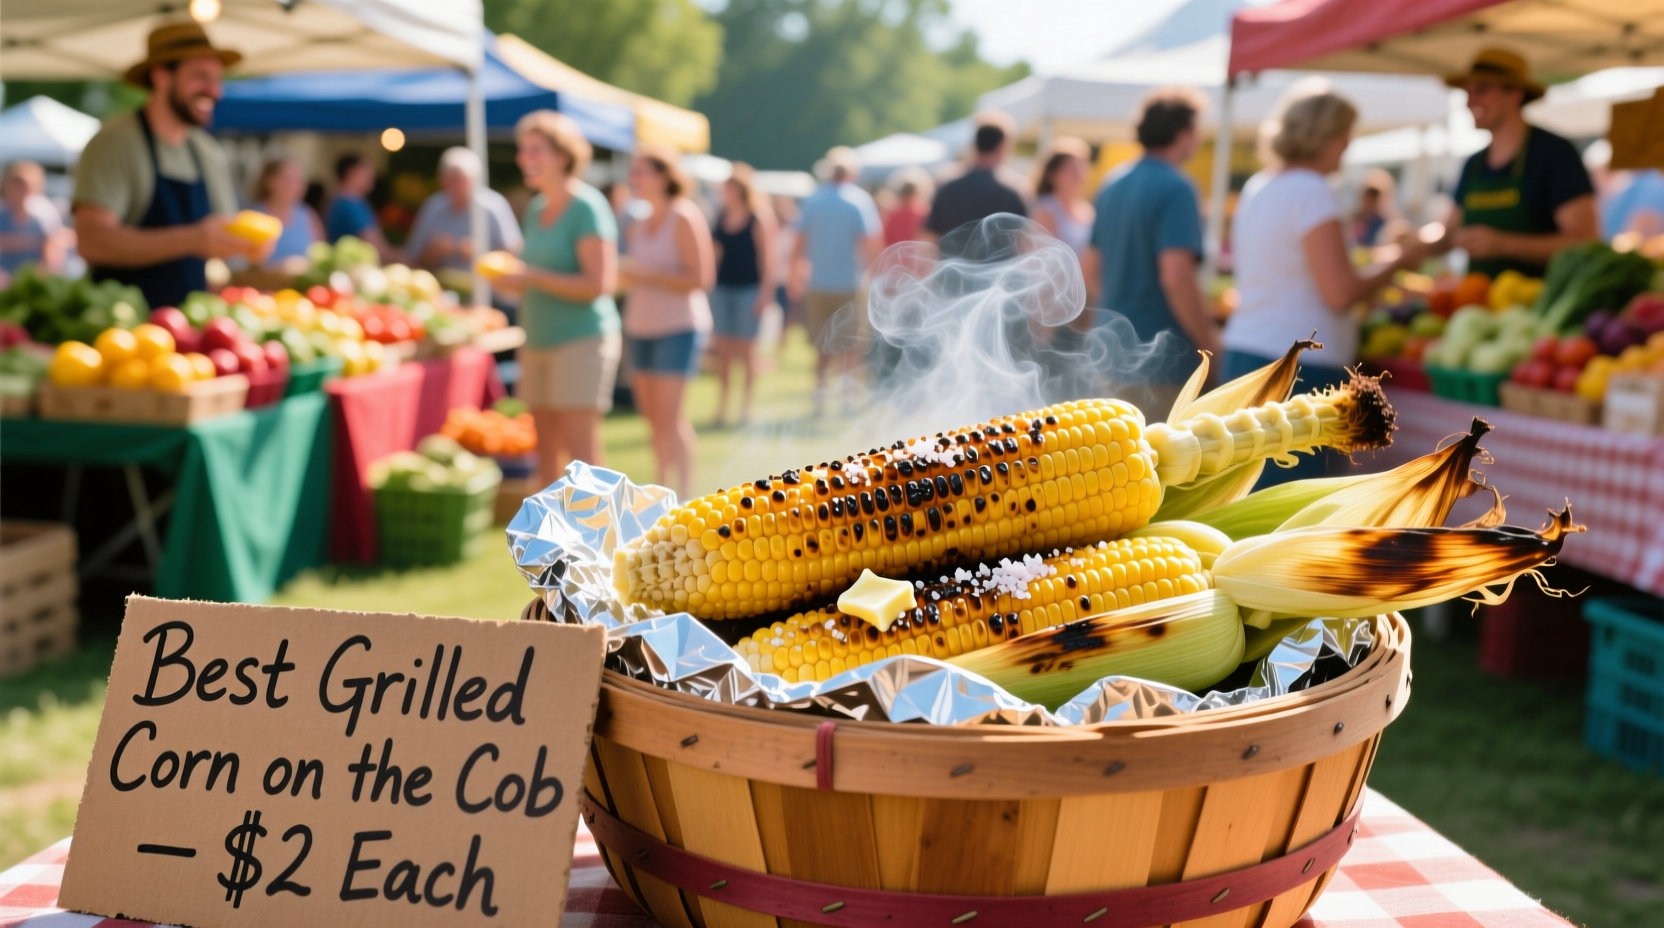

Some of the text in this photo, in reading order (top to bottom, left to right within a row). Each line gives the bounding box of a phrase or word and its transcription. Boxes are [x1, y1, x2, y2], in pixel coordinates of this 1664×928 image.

[132, 620, 535, 738] Best Grilled
[109, 720, 564, 818] Corn on the Cob
[216, 809, 313, 910] $2
[339, 830, 499, 918] Each
